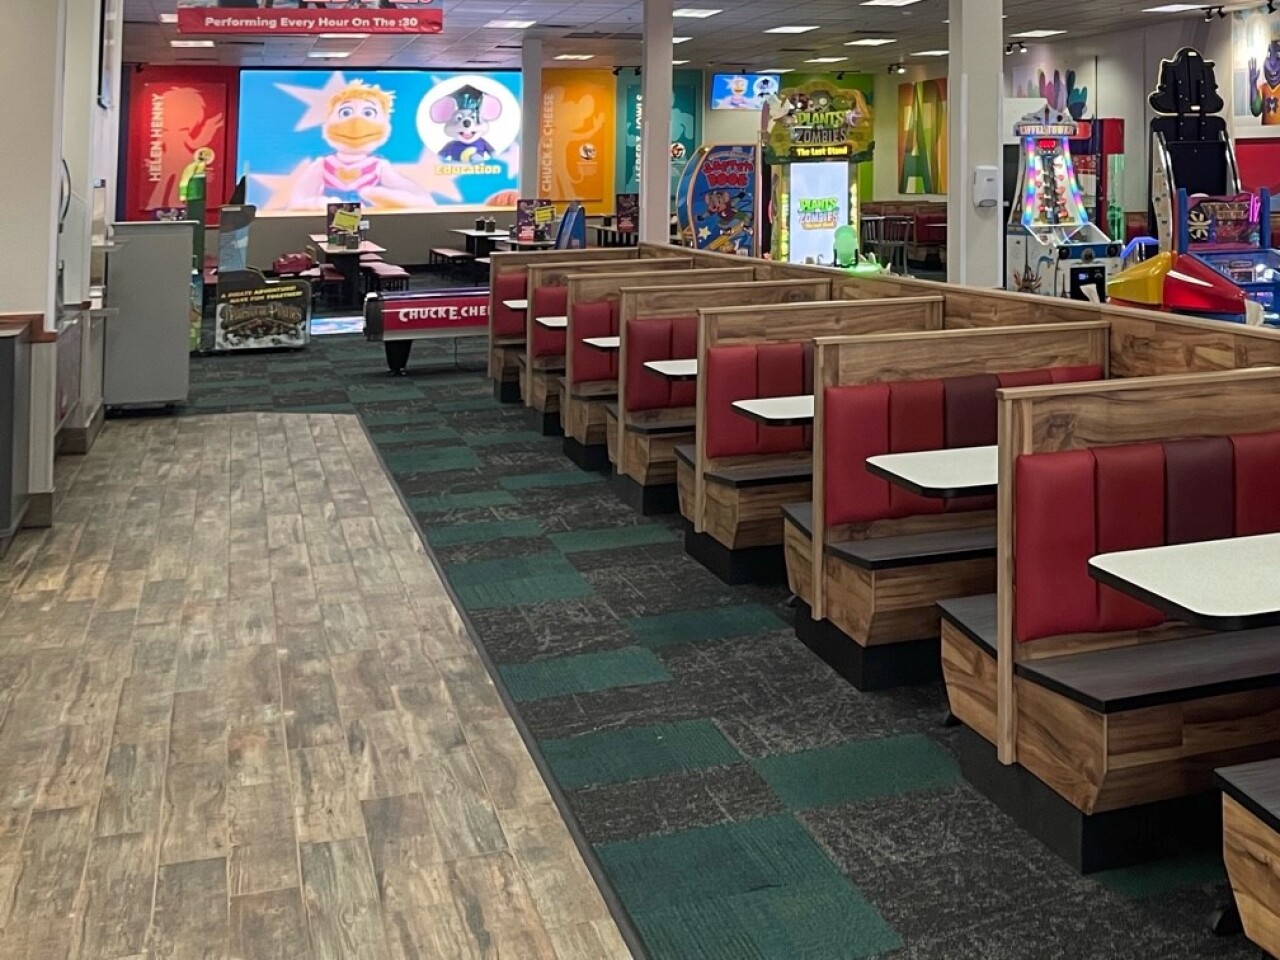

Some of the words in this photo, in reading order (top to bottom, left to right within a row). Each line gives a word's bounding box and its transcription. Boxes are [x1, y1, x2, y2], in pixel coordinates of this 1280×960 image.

[204, 16, 278, 29] Performing
[280, 17, 316, 29] Every
[318, 17, 350, 27] Hour
[351, 17, 370, 27] On
[372, 17, 396, 27] The
[398, 17, 418, 28] :30
[151, 93, 165, 138] HENNY
[542, 93, 555, 137] CHEESE
[796, 110, 847, 128] PLANTS
[542, 138, 553, 149] E.
[794, 127, 847, 144] ZOMBIES
[150, 139, 163, 182] HELEN
[796, 148, 810, 157] The
[435, 165, 502, 175] Education
[541, 152, 553, 193] CHUCK
[398, 307, 447, 322] CHUCK
[448, 306, 461, 320] E.
